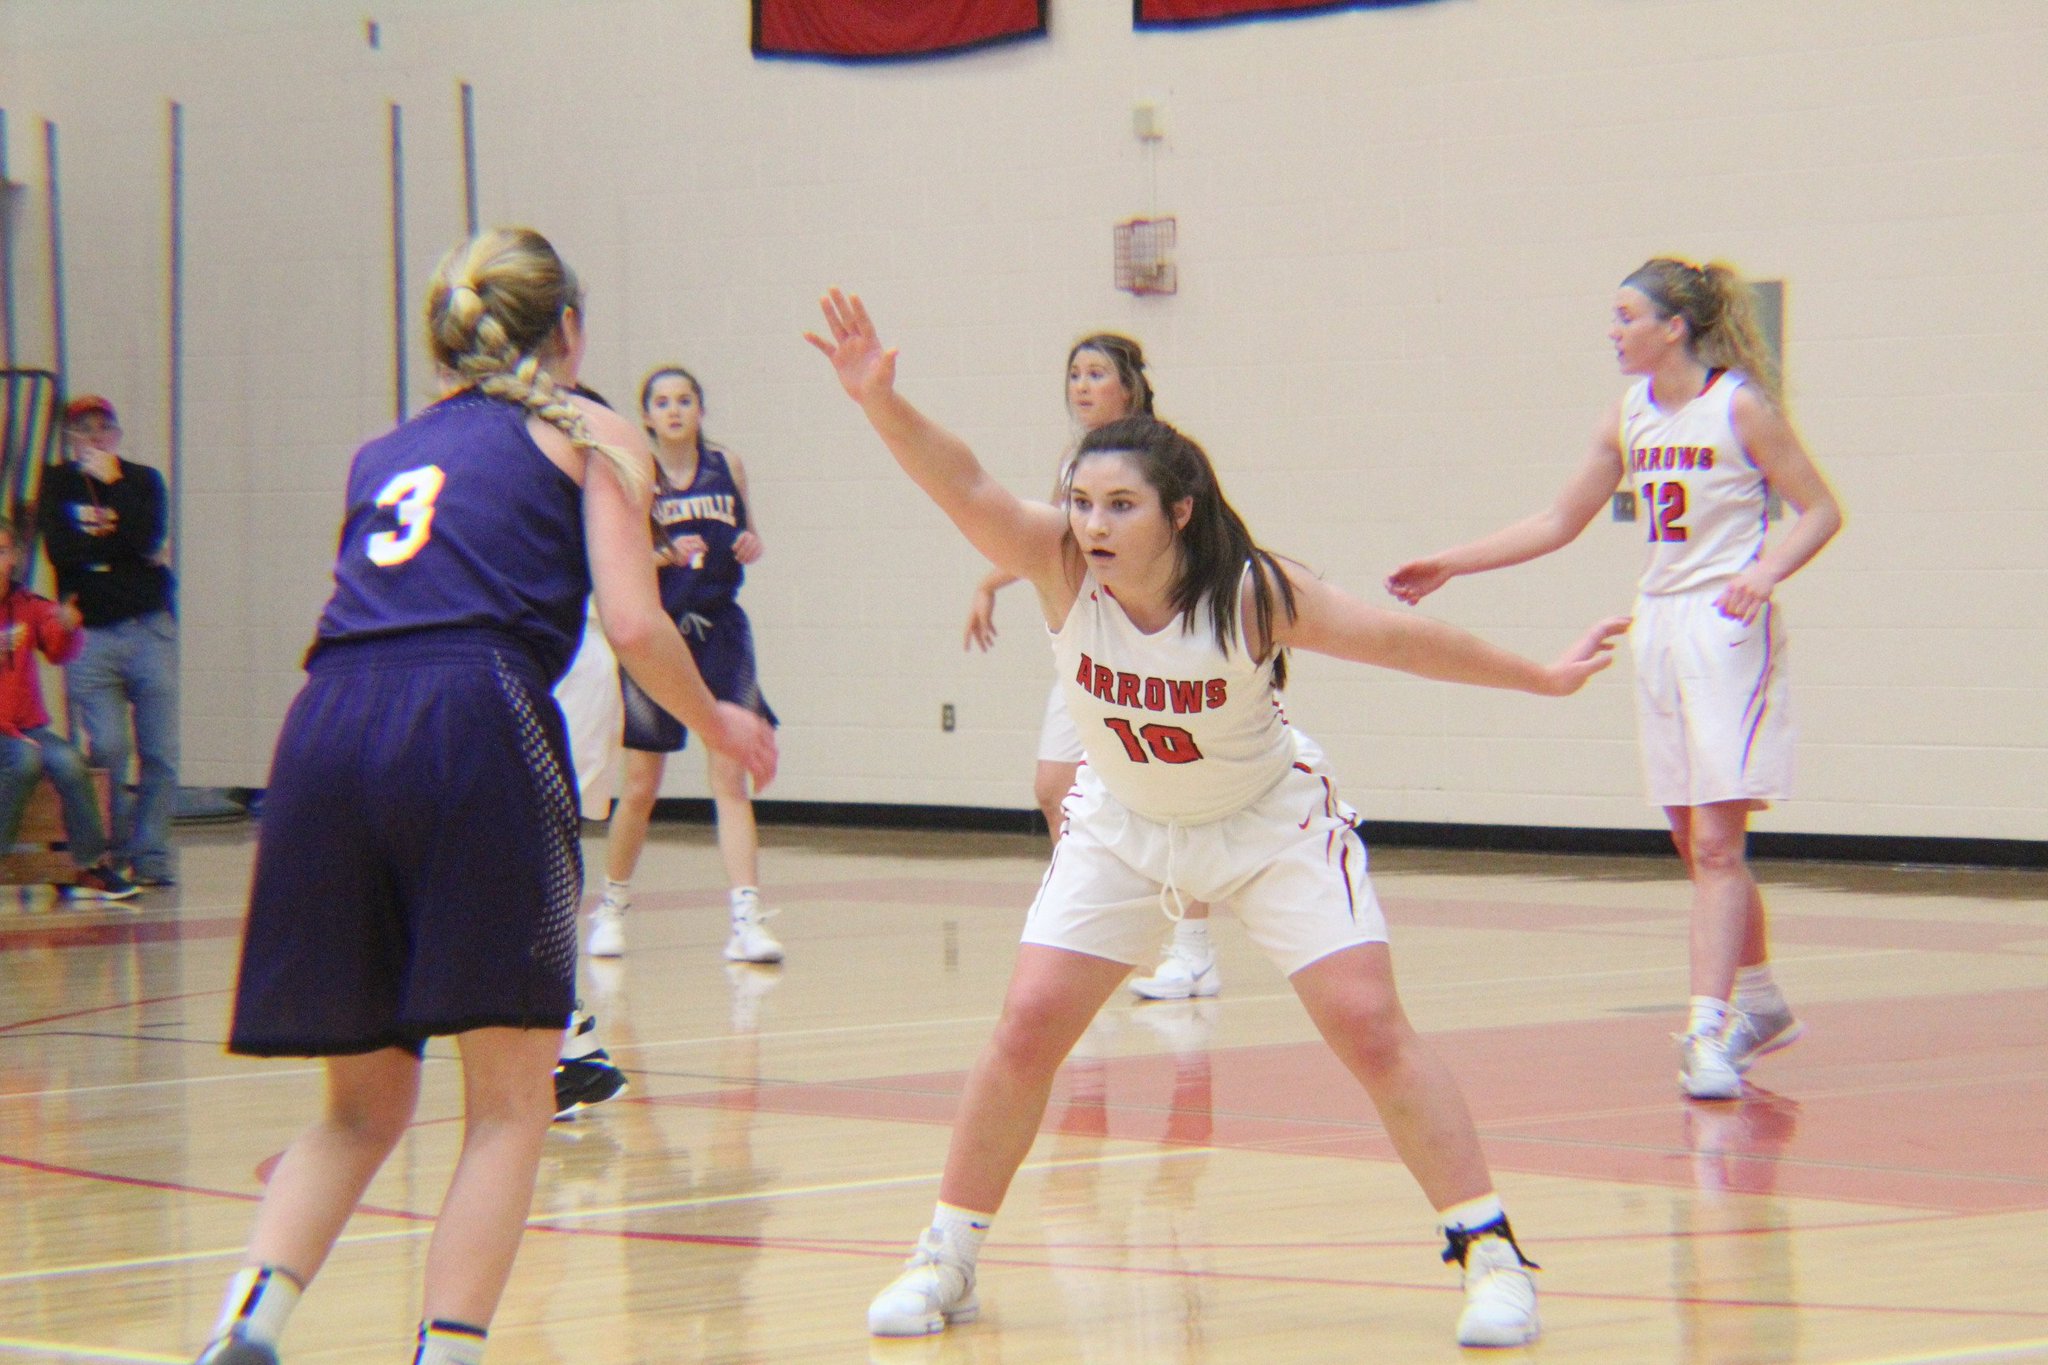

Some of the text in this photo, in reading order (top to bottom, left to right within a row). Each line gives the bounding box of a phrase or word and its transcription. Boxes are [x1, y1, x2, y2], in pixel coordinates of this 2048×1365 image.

[364, 464, 447, 568] 3
[1641, 481, 1688, 543] 12
[1075, 652, 1228, 714] ARROWS
[1103, 717, 1204, 764] 10
